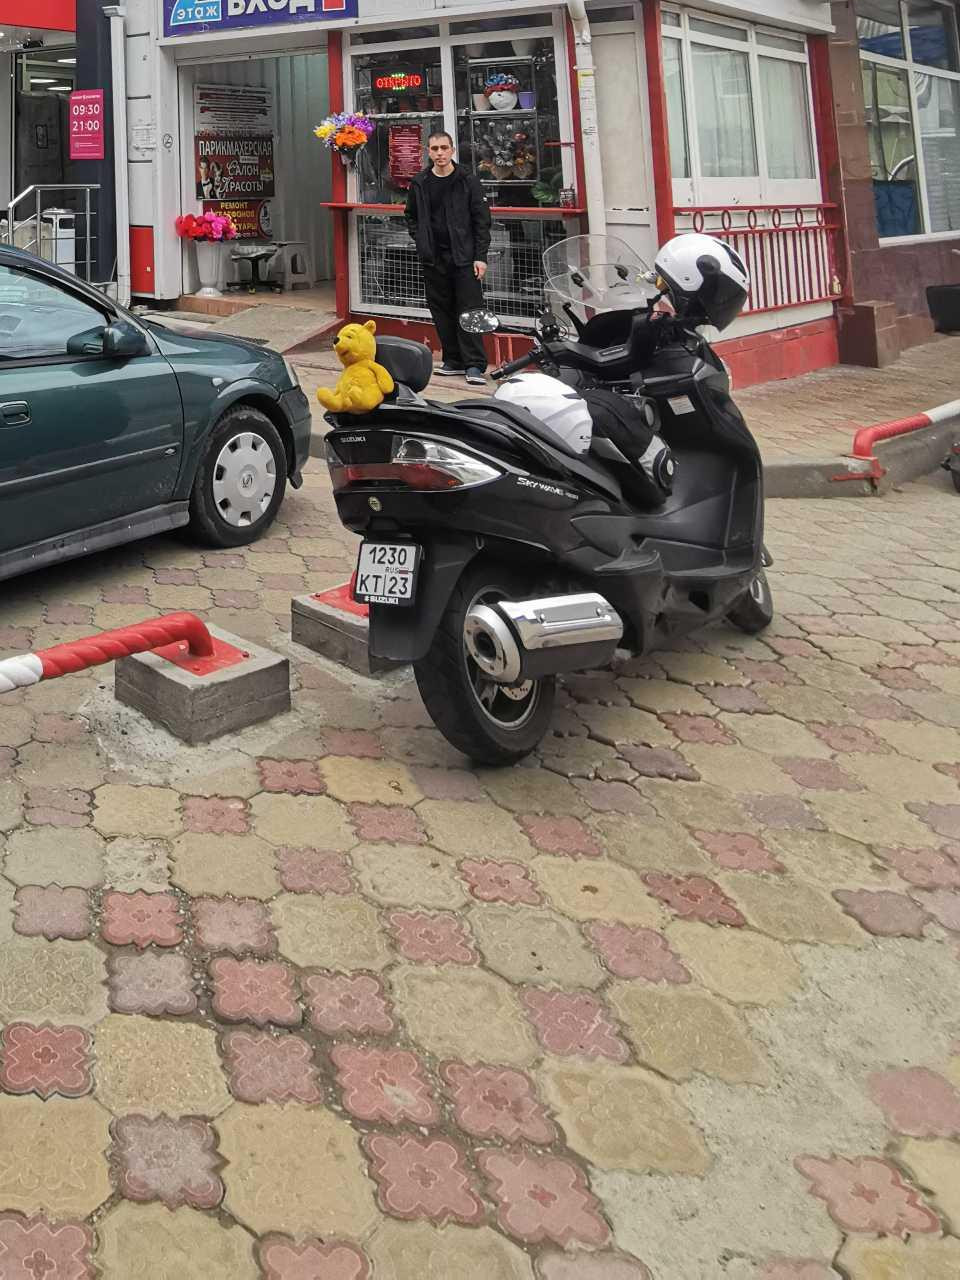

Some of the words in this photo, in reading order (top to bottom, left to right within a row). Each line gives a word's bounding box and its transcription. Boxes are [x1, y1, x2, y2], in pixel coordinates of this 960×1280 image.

[176, 4, 218, 20] этаж
[72, 104, 100, 115] 09:30
[72, 120, 100, 131] 21:00
[199, 140, 272, 156] ПАРИКМАХЕРСКАЯ
[220, 201, 248, 209] РЕМОНТ
[369, 546, 407, 566] 1230
[385, 566, 400, 574] RUS
[359, 573, 382, 593] KT
[387, 576, 409, 595] 23
[369, 595, 399, 605] SUZUKI
